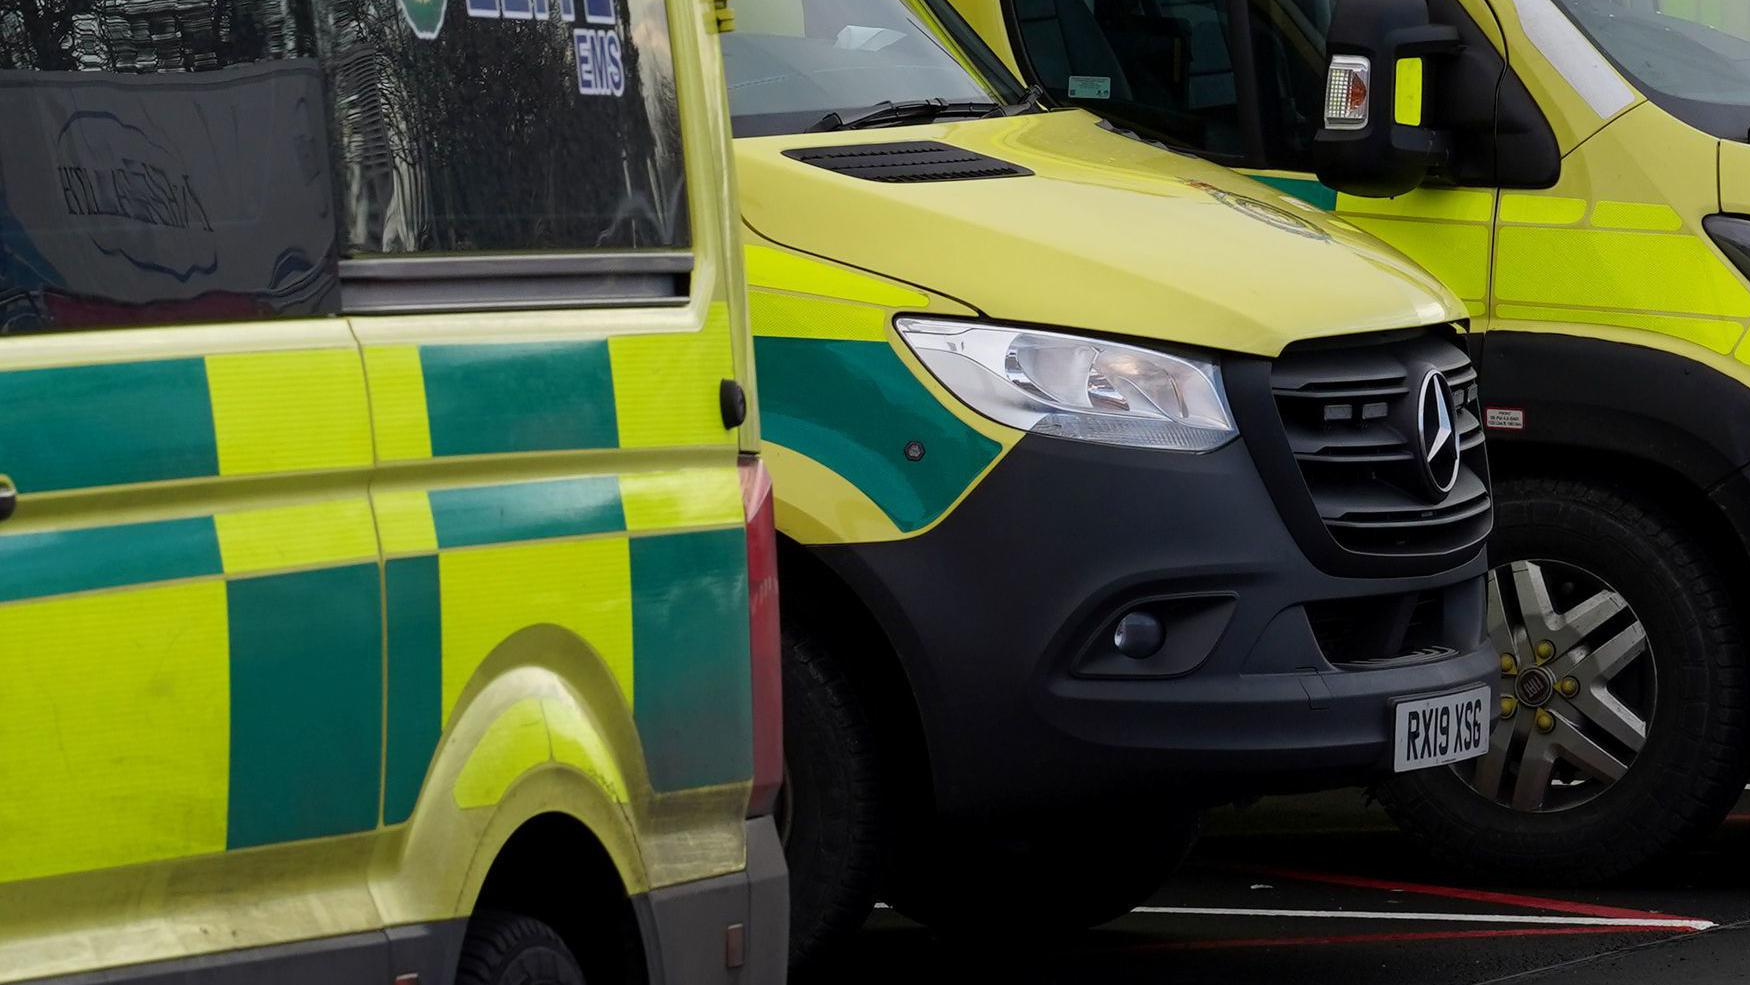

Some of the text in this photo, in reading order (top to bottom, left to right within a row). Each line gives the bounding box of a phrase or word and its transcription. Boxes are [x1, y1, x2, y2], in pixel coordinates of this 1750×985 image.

[573, 28, 626, 97] EMS
[1406, 698, 1482, 761] RX19 XSG
